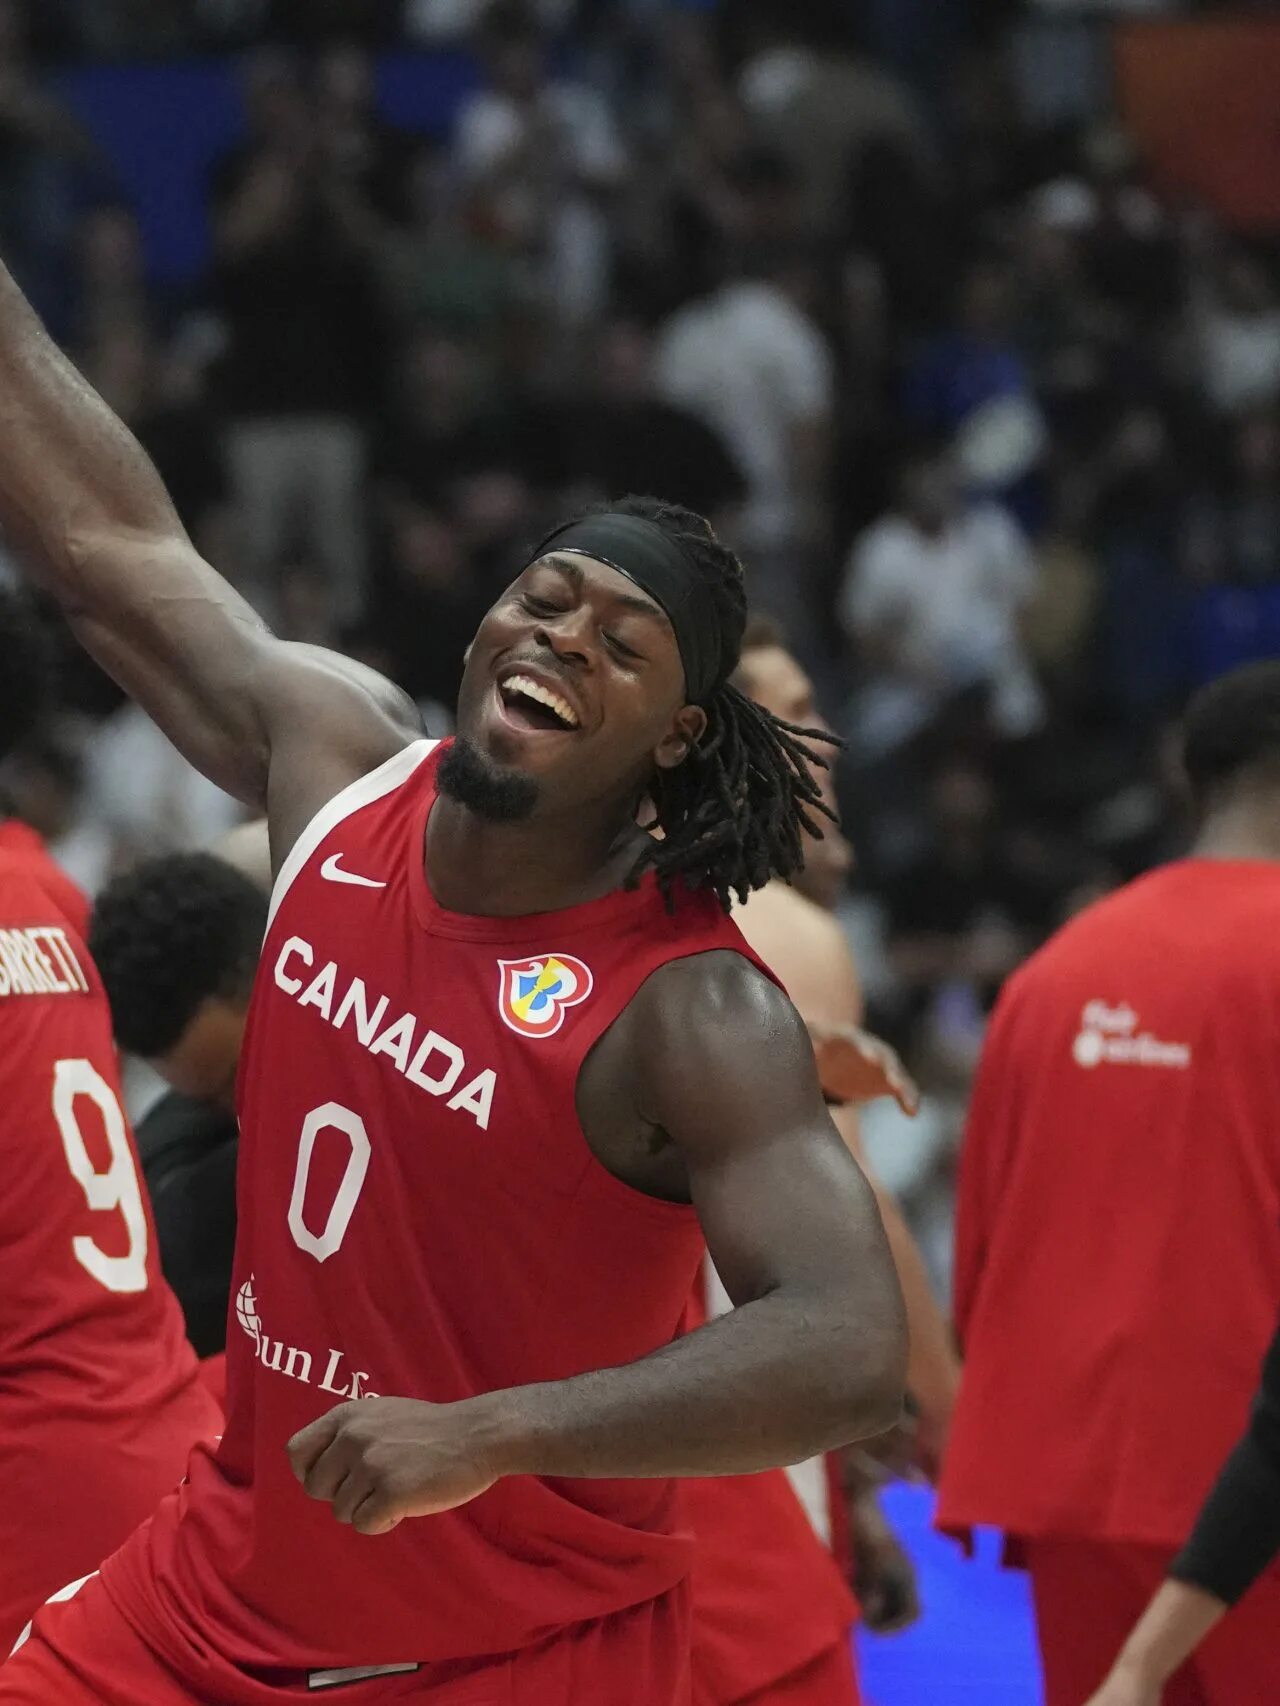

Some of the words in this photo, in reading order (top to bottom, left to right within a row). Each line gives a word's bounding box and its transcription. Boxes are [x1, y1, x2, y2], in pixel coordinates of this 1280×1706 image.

[273, 935, 497, 1131] CANADA
[52, 1058, 149, 1292] 9
[287, 1101, 372, 1263] 0
